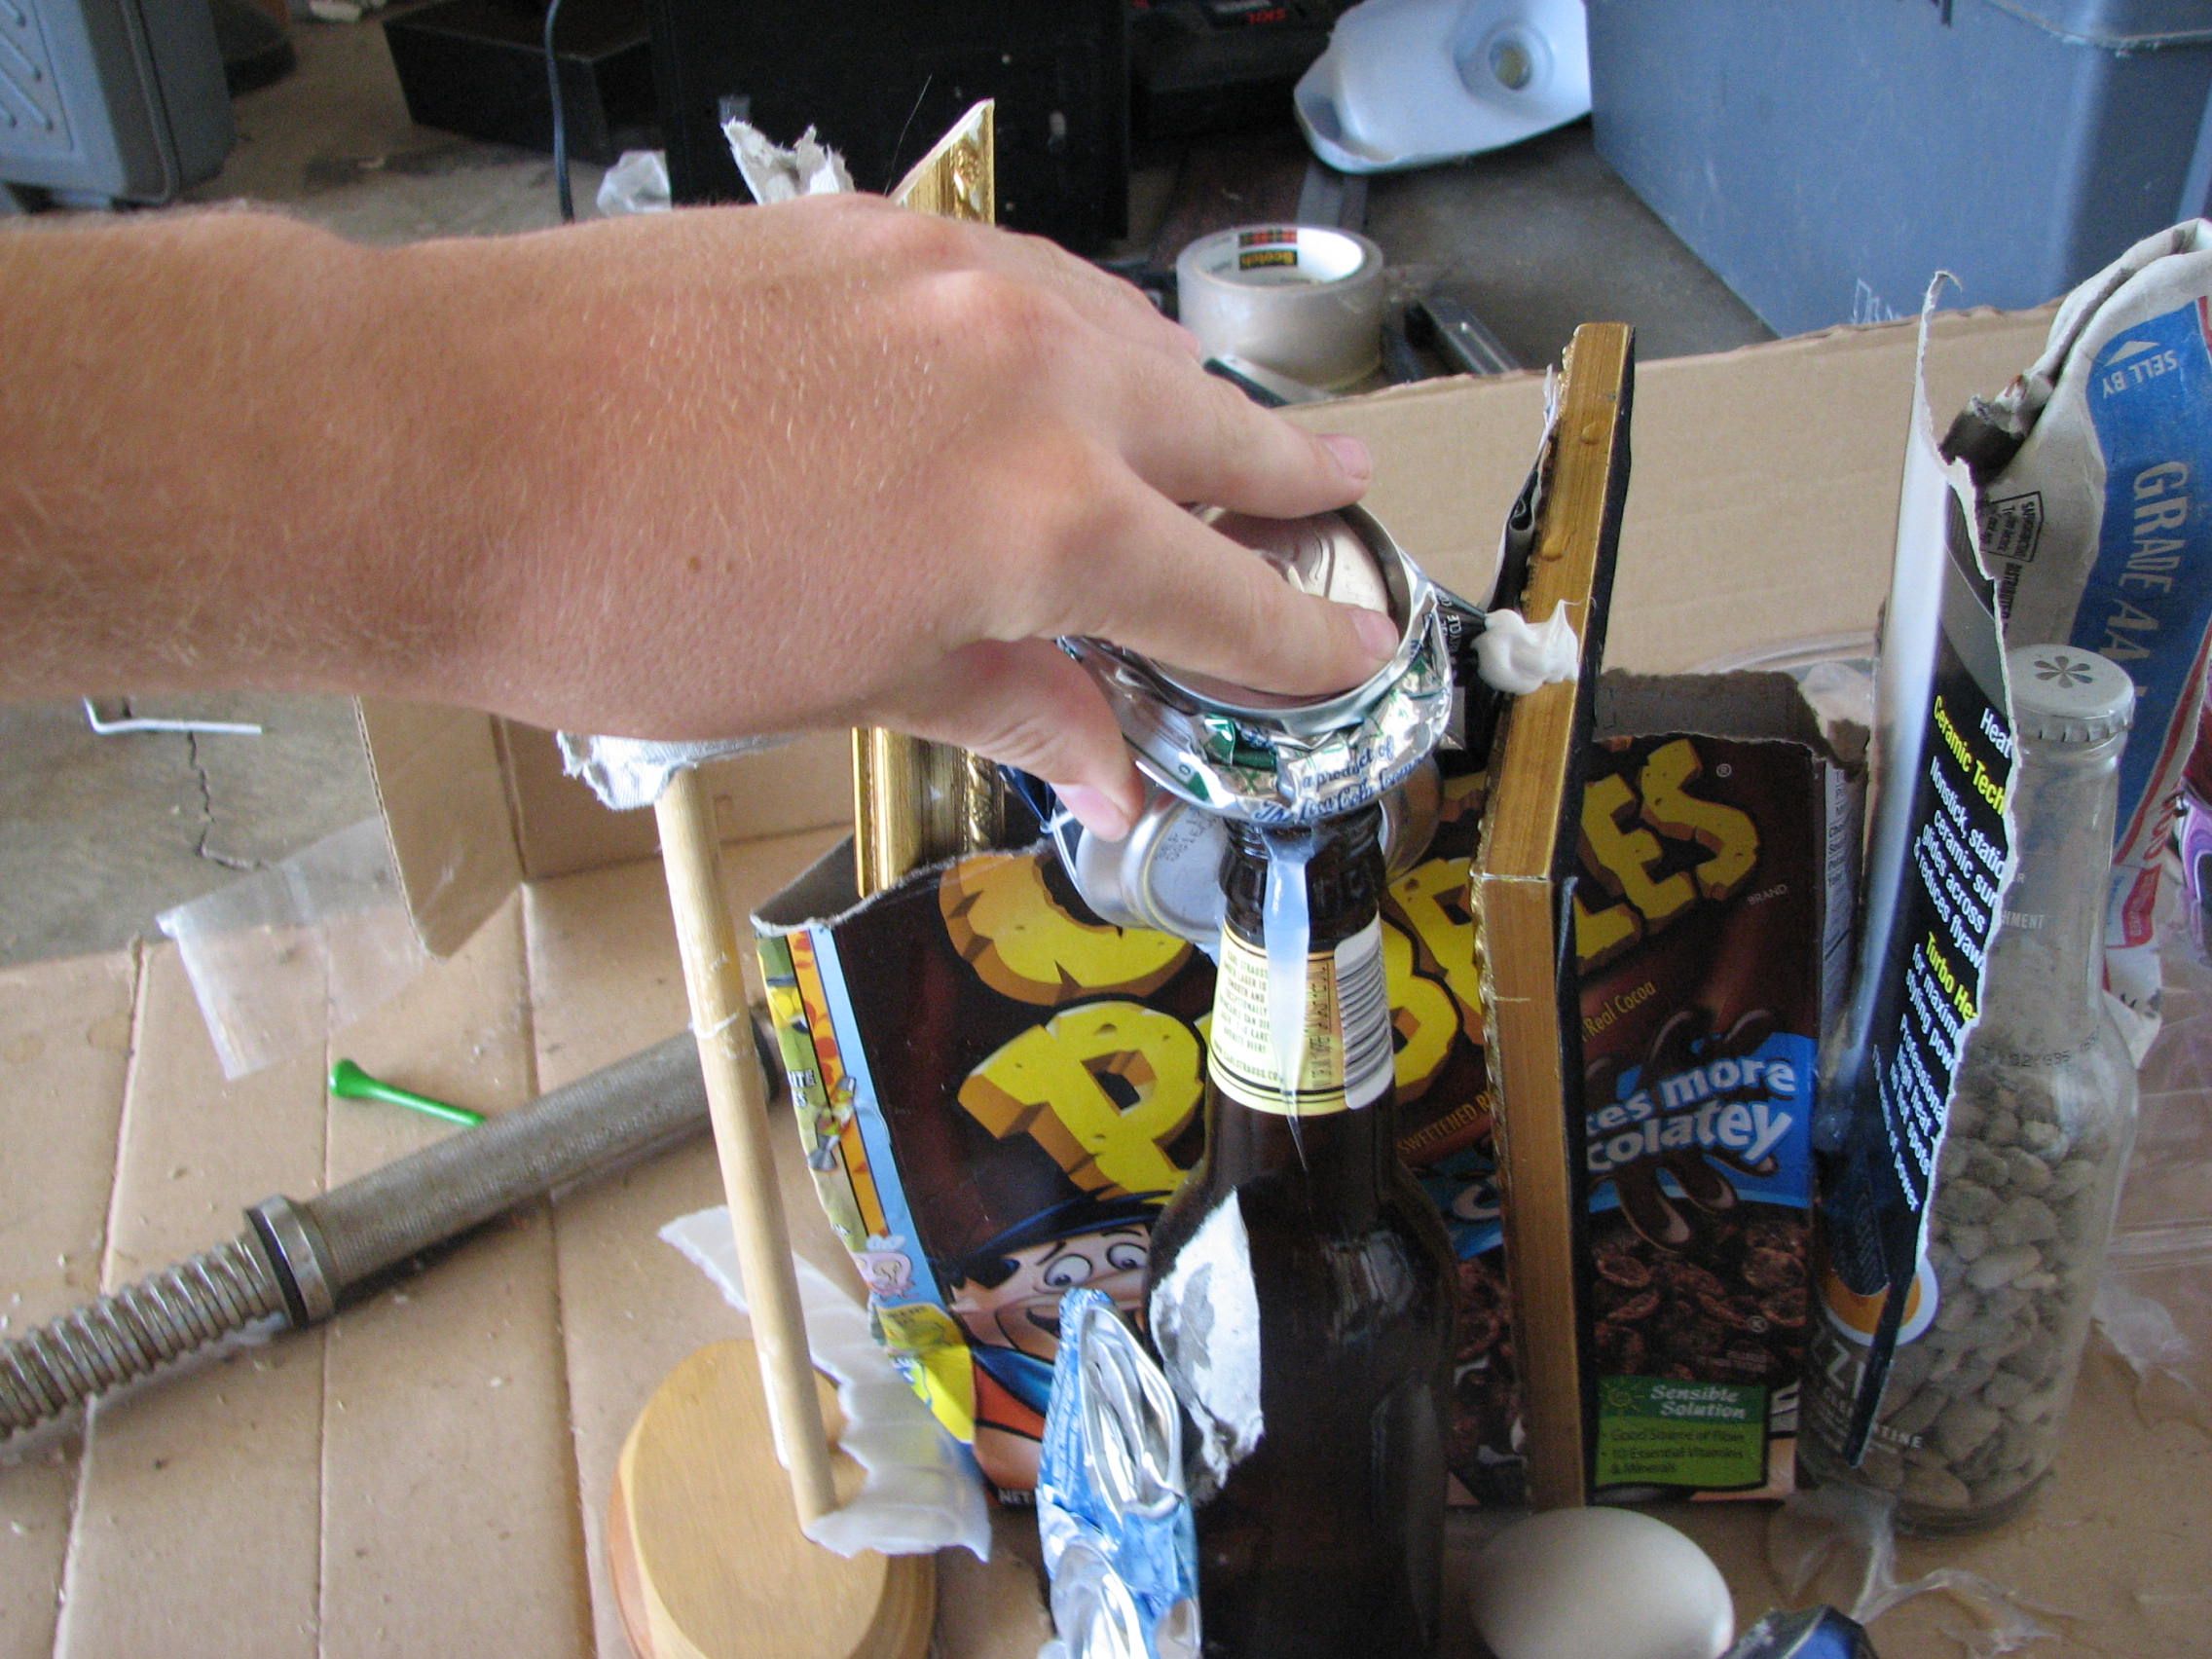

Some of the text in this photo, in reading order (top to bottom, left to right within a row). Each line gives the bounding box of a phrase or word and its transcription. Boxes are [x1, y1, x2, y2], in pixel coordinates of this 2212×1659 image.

[2101, 349, 2178, 399] SELL BY
[1934, 695, 2006, 816] Ceramic Tech
[1979, 707, 2013, 759] Heat
[1317, 748, 1373, 792] product
[1379, 735, 1394, 761] of
[1934, 810, 1973, 878] ceramic
[1748, 884, 1788, 905] BRAND
[1919, 854, 1950, 923] reduces
[1922, 824, 1985, 934] glides across
[1912, 942, 1926, 976] for
[1927, 931, 1955, 993] Turbo
[1584, 981, 1657, 1036] Real Cocoa
[1905, 968, 1932, 1035] styling
[1659, 1057, 1796, 1109] more
[1396, 1103, 1476, 1152] SWEETENED
[1587, 1100, 1793, 1171] colatey
[1911, 1086, 1933, 1136] heat
[1907, 1122, 1930, 1176] spots
[1894, 1152, 1920, 1212] power
[1651, 1383, 1741, 1403] Sensible
[1659, 1401, 1747, 1419] Solution
